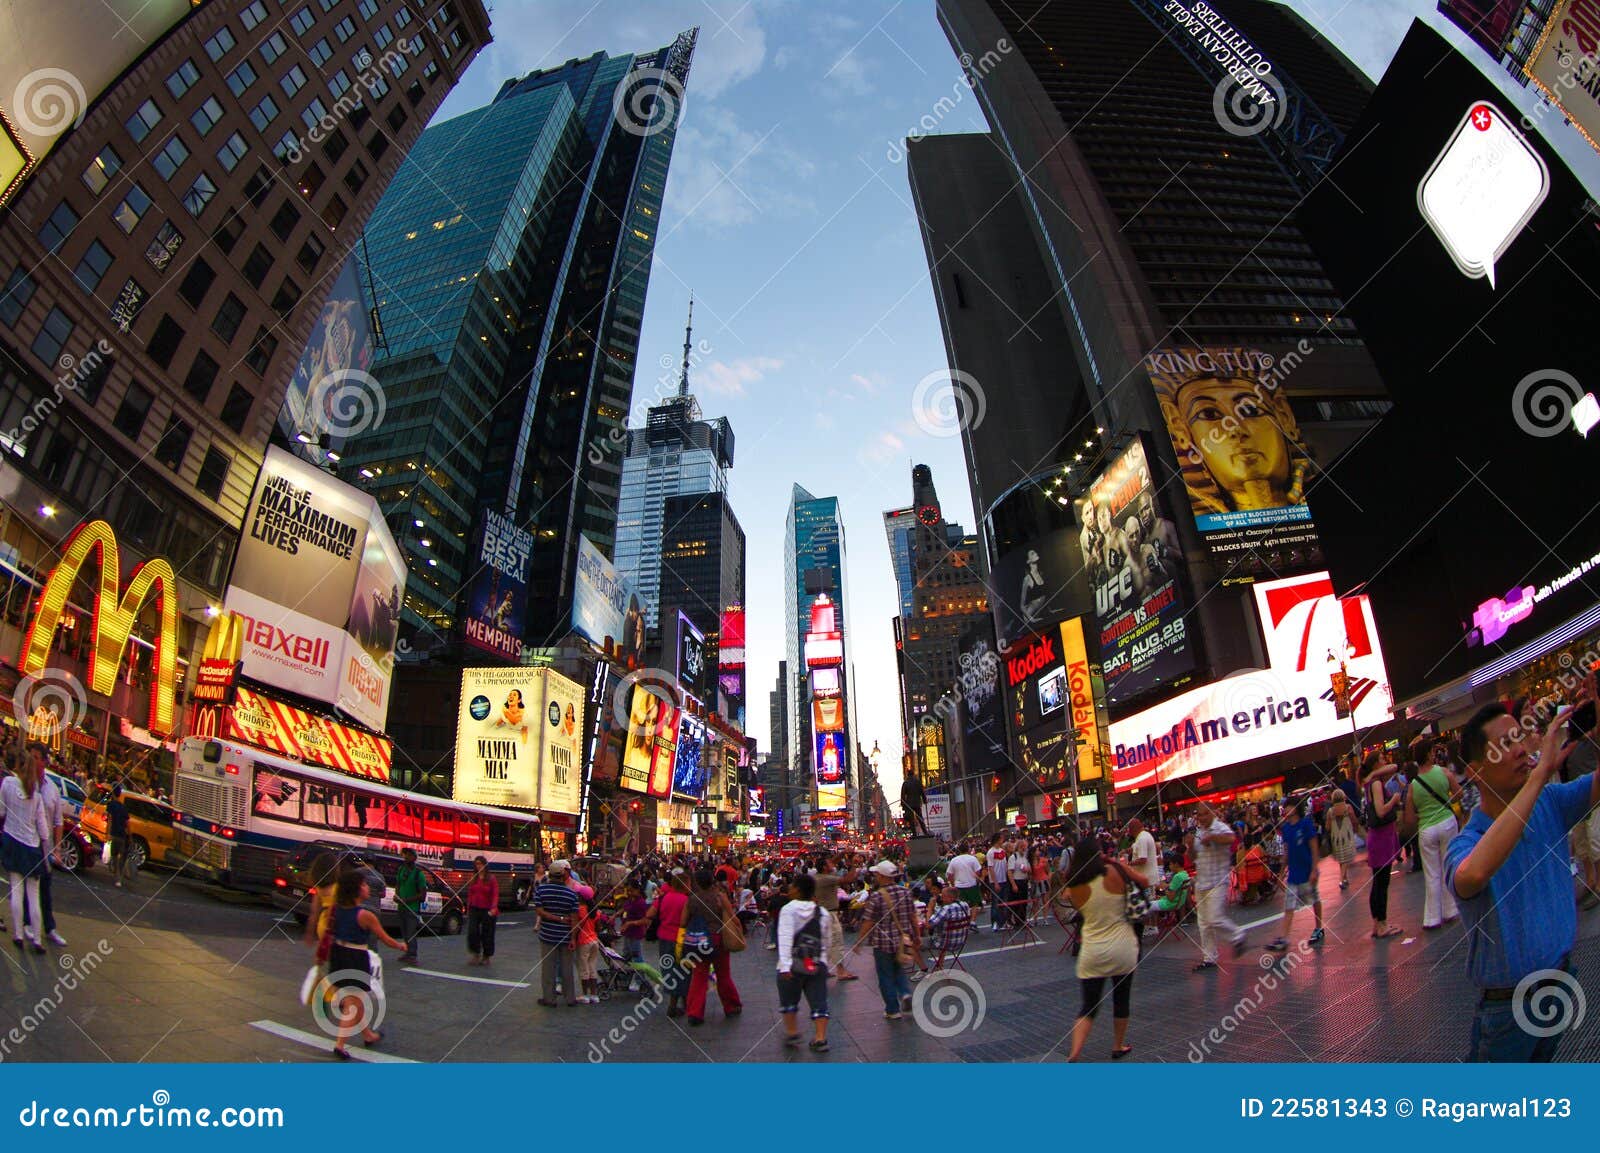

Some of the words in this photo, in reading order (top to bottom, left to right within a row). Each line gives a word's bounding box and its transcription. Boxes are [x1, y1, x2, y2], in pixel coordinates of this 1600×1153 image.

[1164, 0, 1205, 36] EAGLE
[1191, 1, 1272, 76] OUTFITTERS
[1198, 32, 1276, 105] AMERICAN
[1149, 352, 1217, 375] KING
[1217, 351, 1268, 372] TUT
[266, 474, 312, 505] WHERE
[256, 505, 353, 561] PERFORMANCE
[260, 485, 358, 547] MAXIMUM
[486, 508, 534, 547] WINNER!
[250, 519, 300, 556] LIVES
[483, 531, 529, 571] BEST
[1217, 543, 1240, 552] BLOCKS
[1241, 541, 1261, 549] SOUTH
[1279, 536, 1305, 544] BETWEEN
[481, 550, 526, 584] MUSICAL
[1552, 567, 1582, 592] friends
[1096, 566, 1133, 618] UFC
[1134, 605, 1147, 625] VS
[230, 609, 330, 669] maxell
[466, 617, 522, 657] MEMPHIS
[1132, 630, 1186, 667] PAY-PER-VIEW
[199, 665, 233, 676] McDonald's
[251, 649, 325, 677] www.maxell.com
[1007, 634, 1056, 687] Kodak
[1103, 651, 1128, 674] SAT.
[348, 656, 384, 709] maxell
[1068, 660, 1095, 740] Kodak
[238, 710, 271, 729] FRIDAY'S
[1115, 732, 1158, 769] Bank
[1160, 723, 1179, 756] of
[1183, 696, 1311, 750] America
[299, 732, 328, 747] FRIDAY'S
[351, 749, 377, 762] FRIDAY'S
[476, 739, 517, 760] MAMMA
[550, 743, 572, 768] MAMMA
[484, 760, 509, 780] MIA!
[554, 764, 567, 784] MIA!
[1054, 789, 1097, 799] MARUIS
